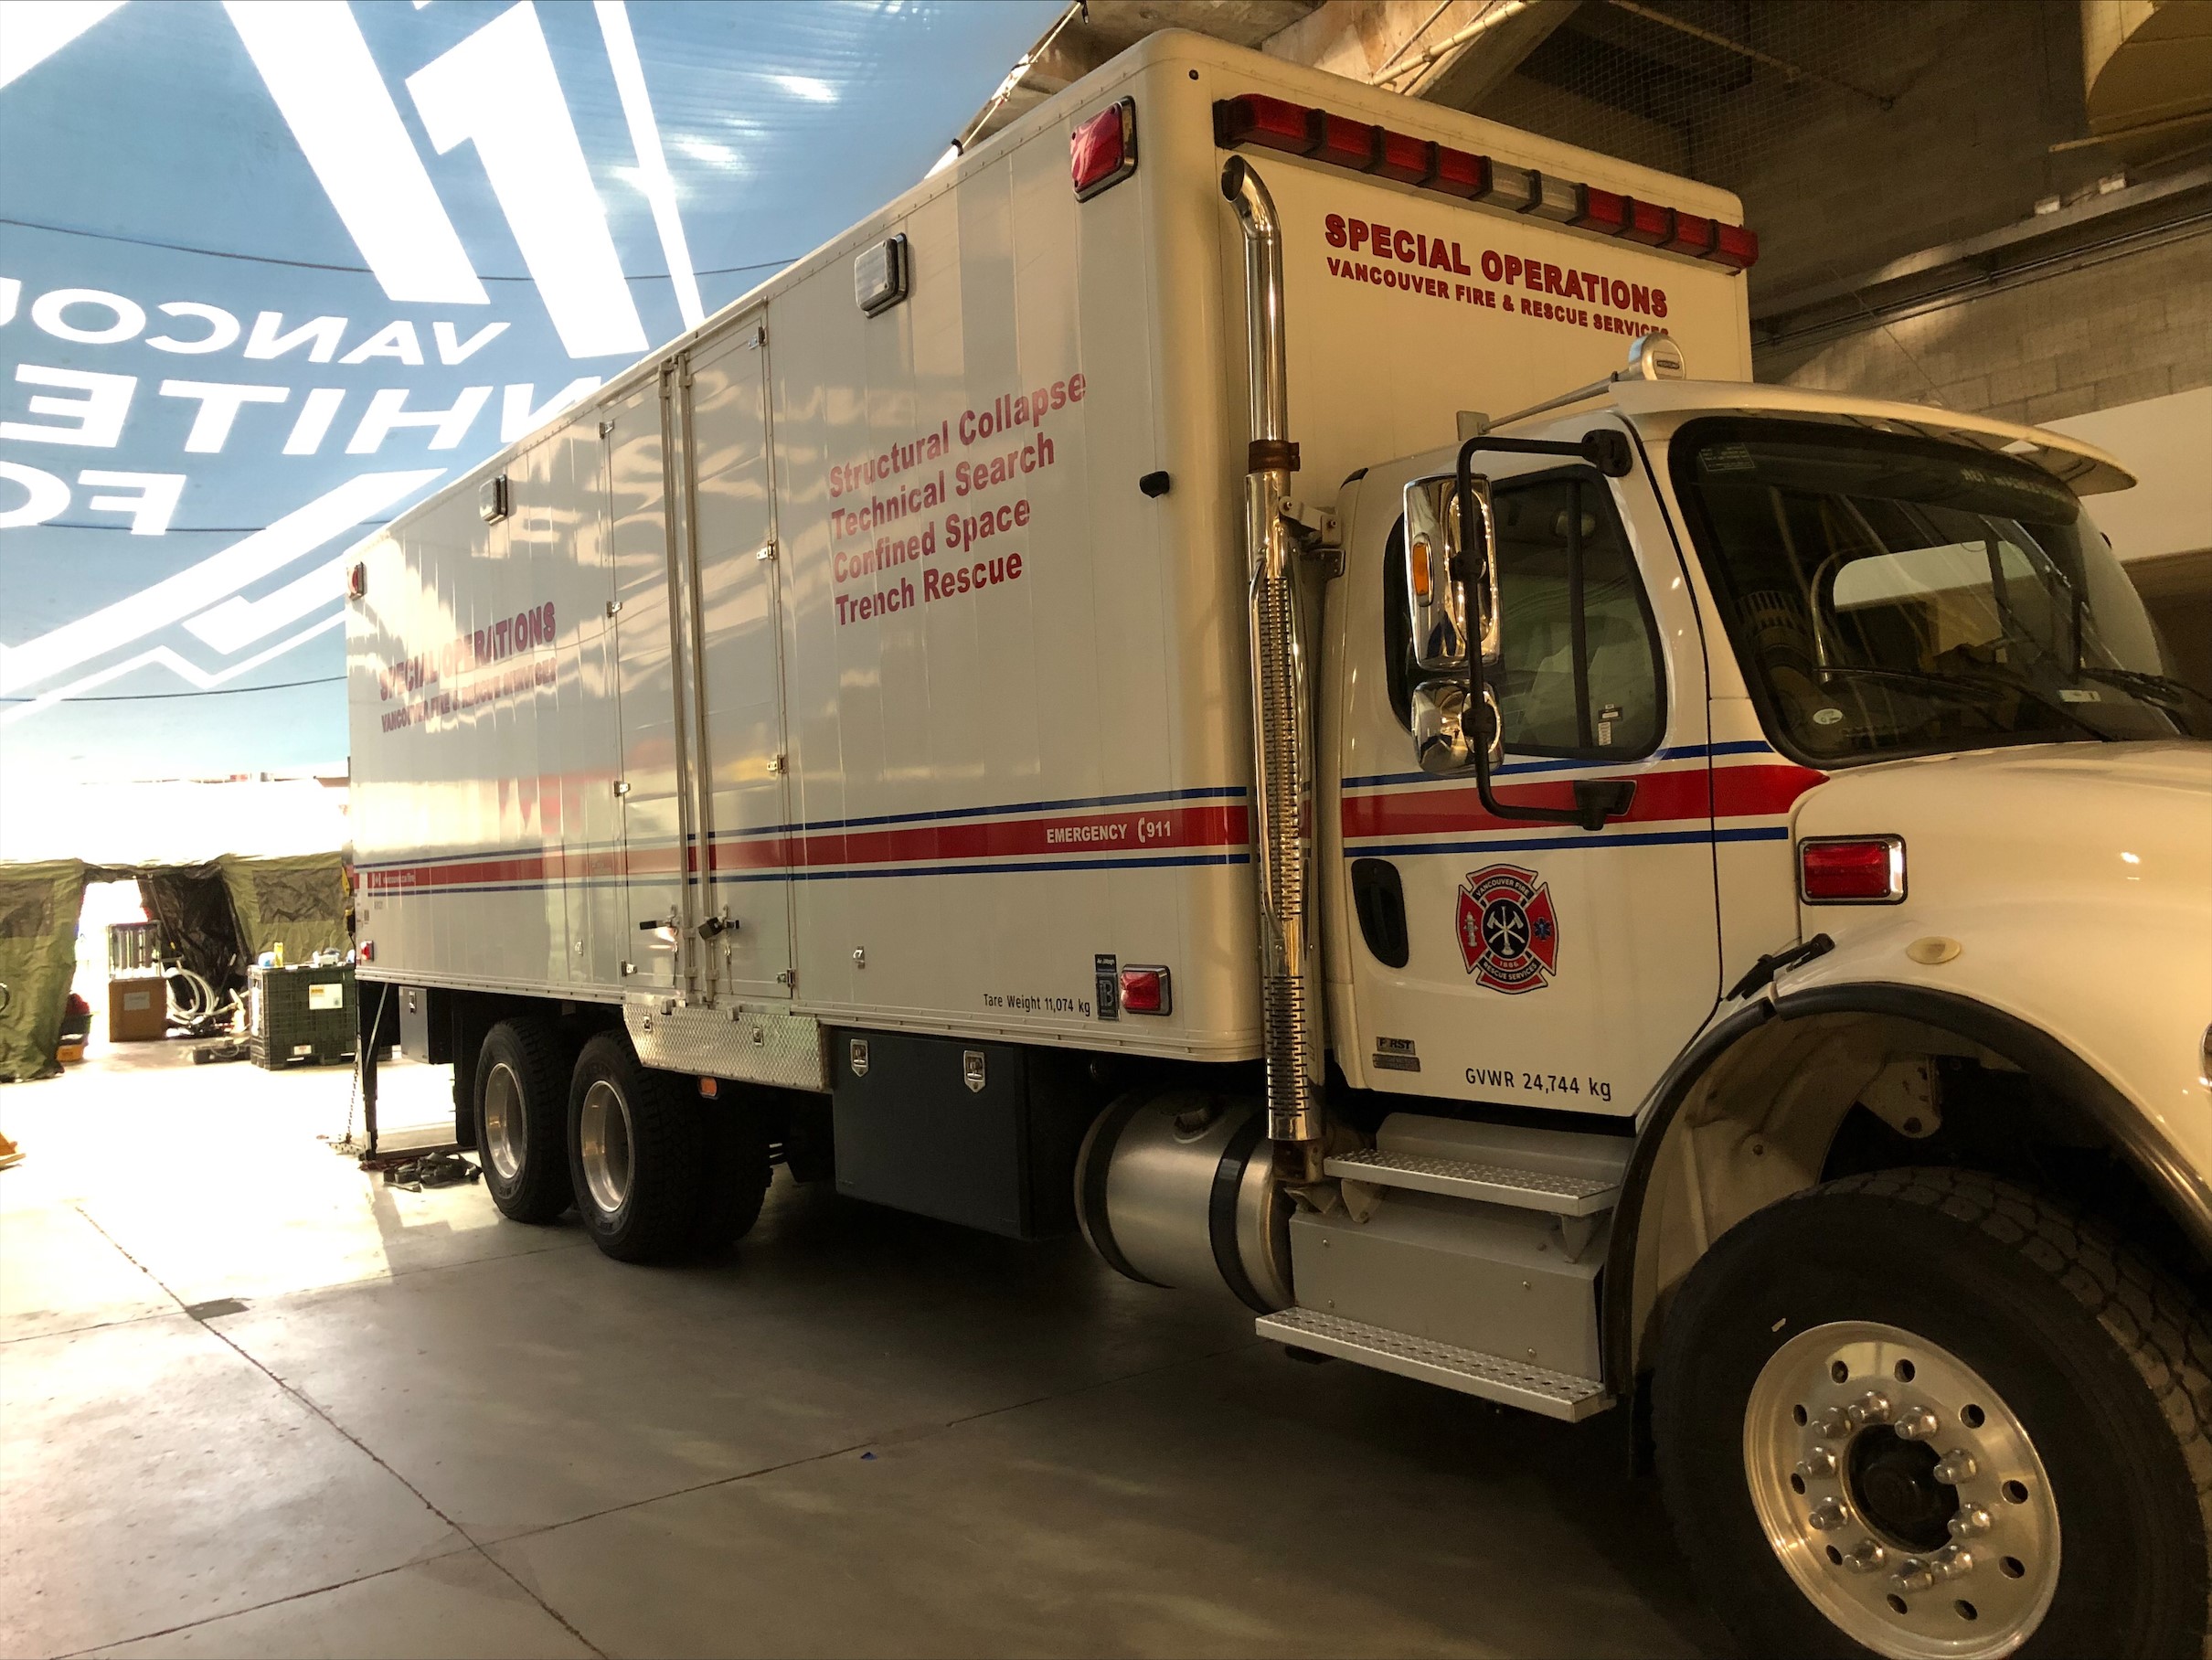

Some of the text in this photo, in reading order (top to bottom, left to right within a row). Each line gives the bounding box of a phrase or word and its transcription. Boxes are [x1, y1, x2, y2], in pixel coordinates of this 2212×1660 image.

[1324, 213, 1668, 318] SPECIAL OPERATIONS
[1327, 257, 1450, 300] VANCOUVER
[1455, 284, 1496, 309] FIRE
[1502, 294, 1515, 312] &
[1521, 298, 1588, 327] RESCUE
[829, 372, 1087, 498] Structural Collapse
[831, 431, 1055, 540] Technical Search
[833, 498, 1031, 583] Confined Space
[835, 552, 1023, 626] Trench Rescue
[379, 601, 557, 702] SPECIAL OPERATIONS
[381, 700, 429, 733] VANCOUVER
[1046, 820, 1173, 844] EMERGENCY 911
[1475, 878, 1530, 897] VANCOUVER FIRE
[1483, 961, 1537, 980] RESCUE SERVICES
[984, 993, 1090, 1017] Tare Weight 11,074 kg
[1379, 1038, 1410, 1049] FRST
[1465, 1068, 1611, 1102] GVWR 24,744 kg
